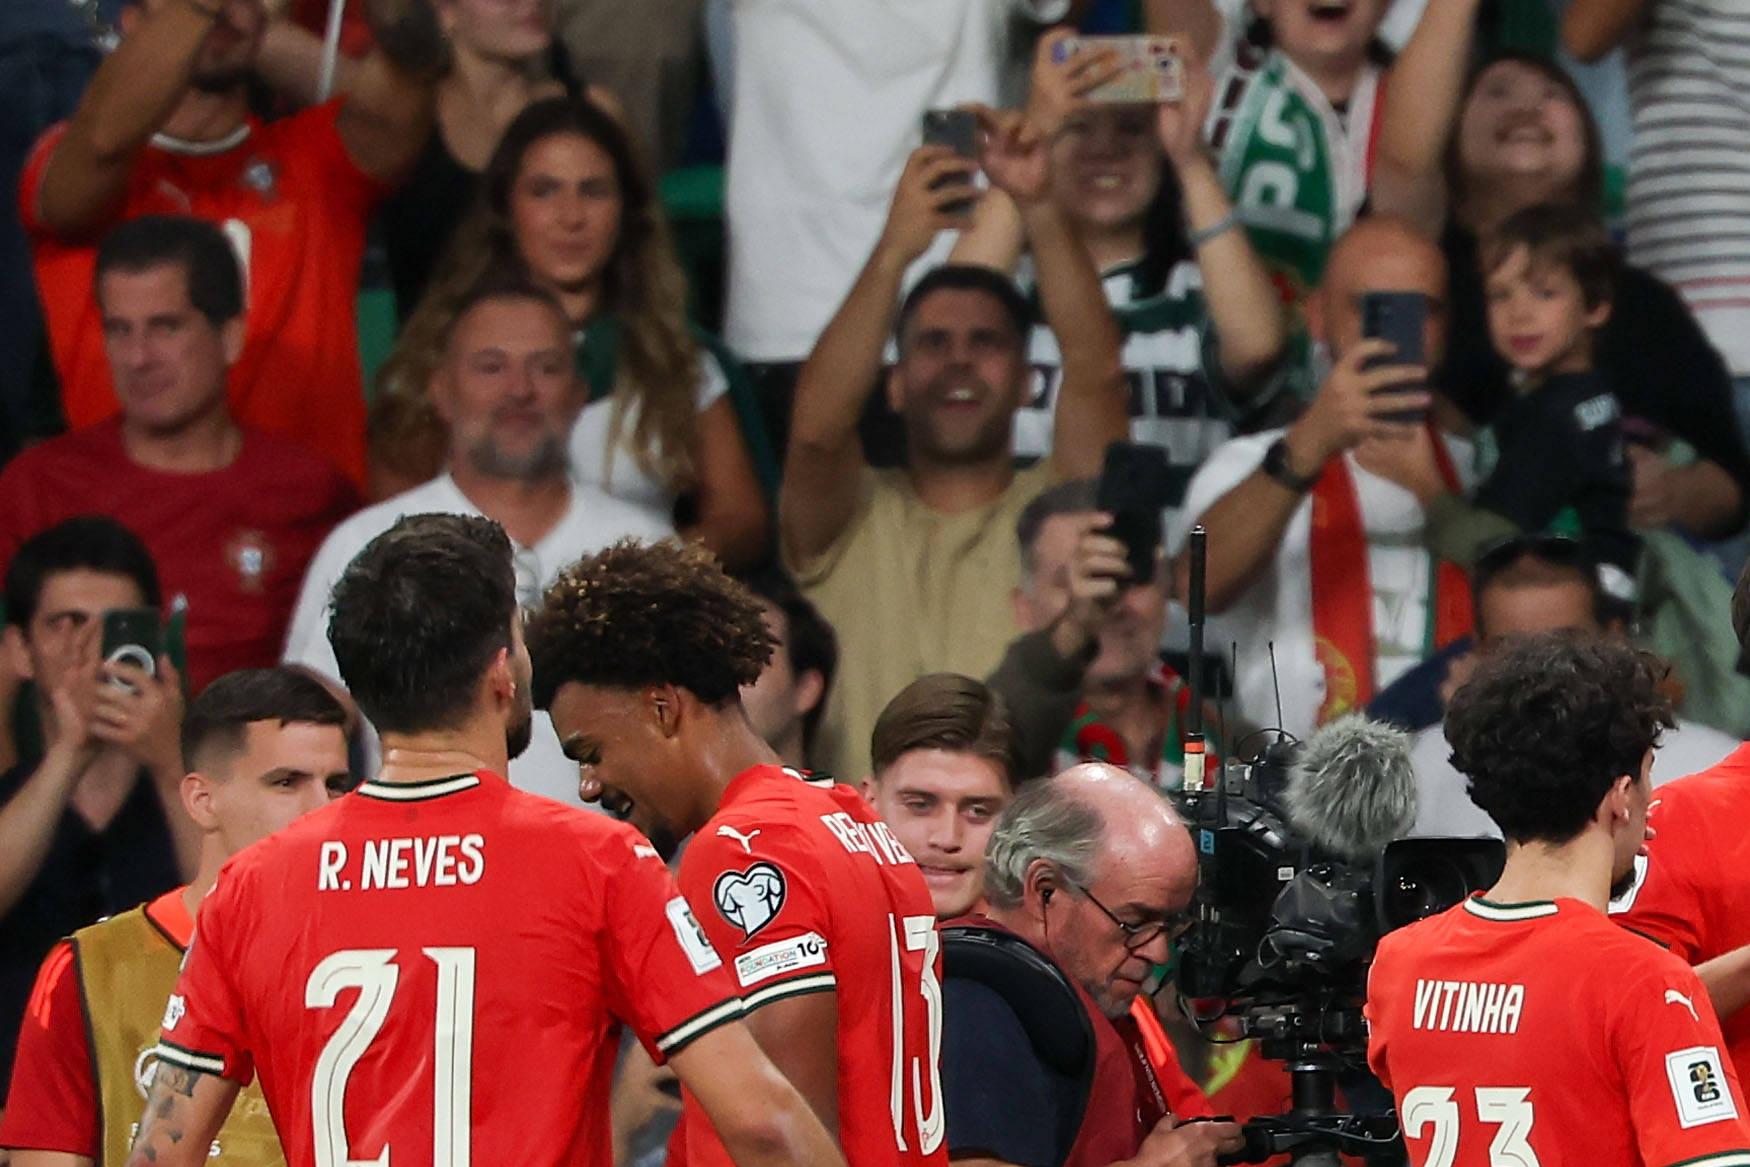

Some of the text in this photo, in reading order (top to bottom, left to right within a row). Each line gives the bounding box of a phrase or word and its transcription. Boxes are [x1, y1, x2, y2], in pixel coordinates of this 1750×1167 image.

[318, 834, 486, 891] R. NEVES
[888, 912, 946, 1156] 13
[1412, 978, 1525, 1034] VITINHA
